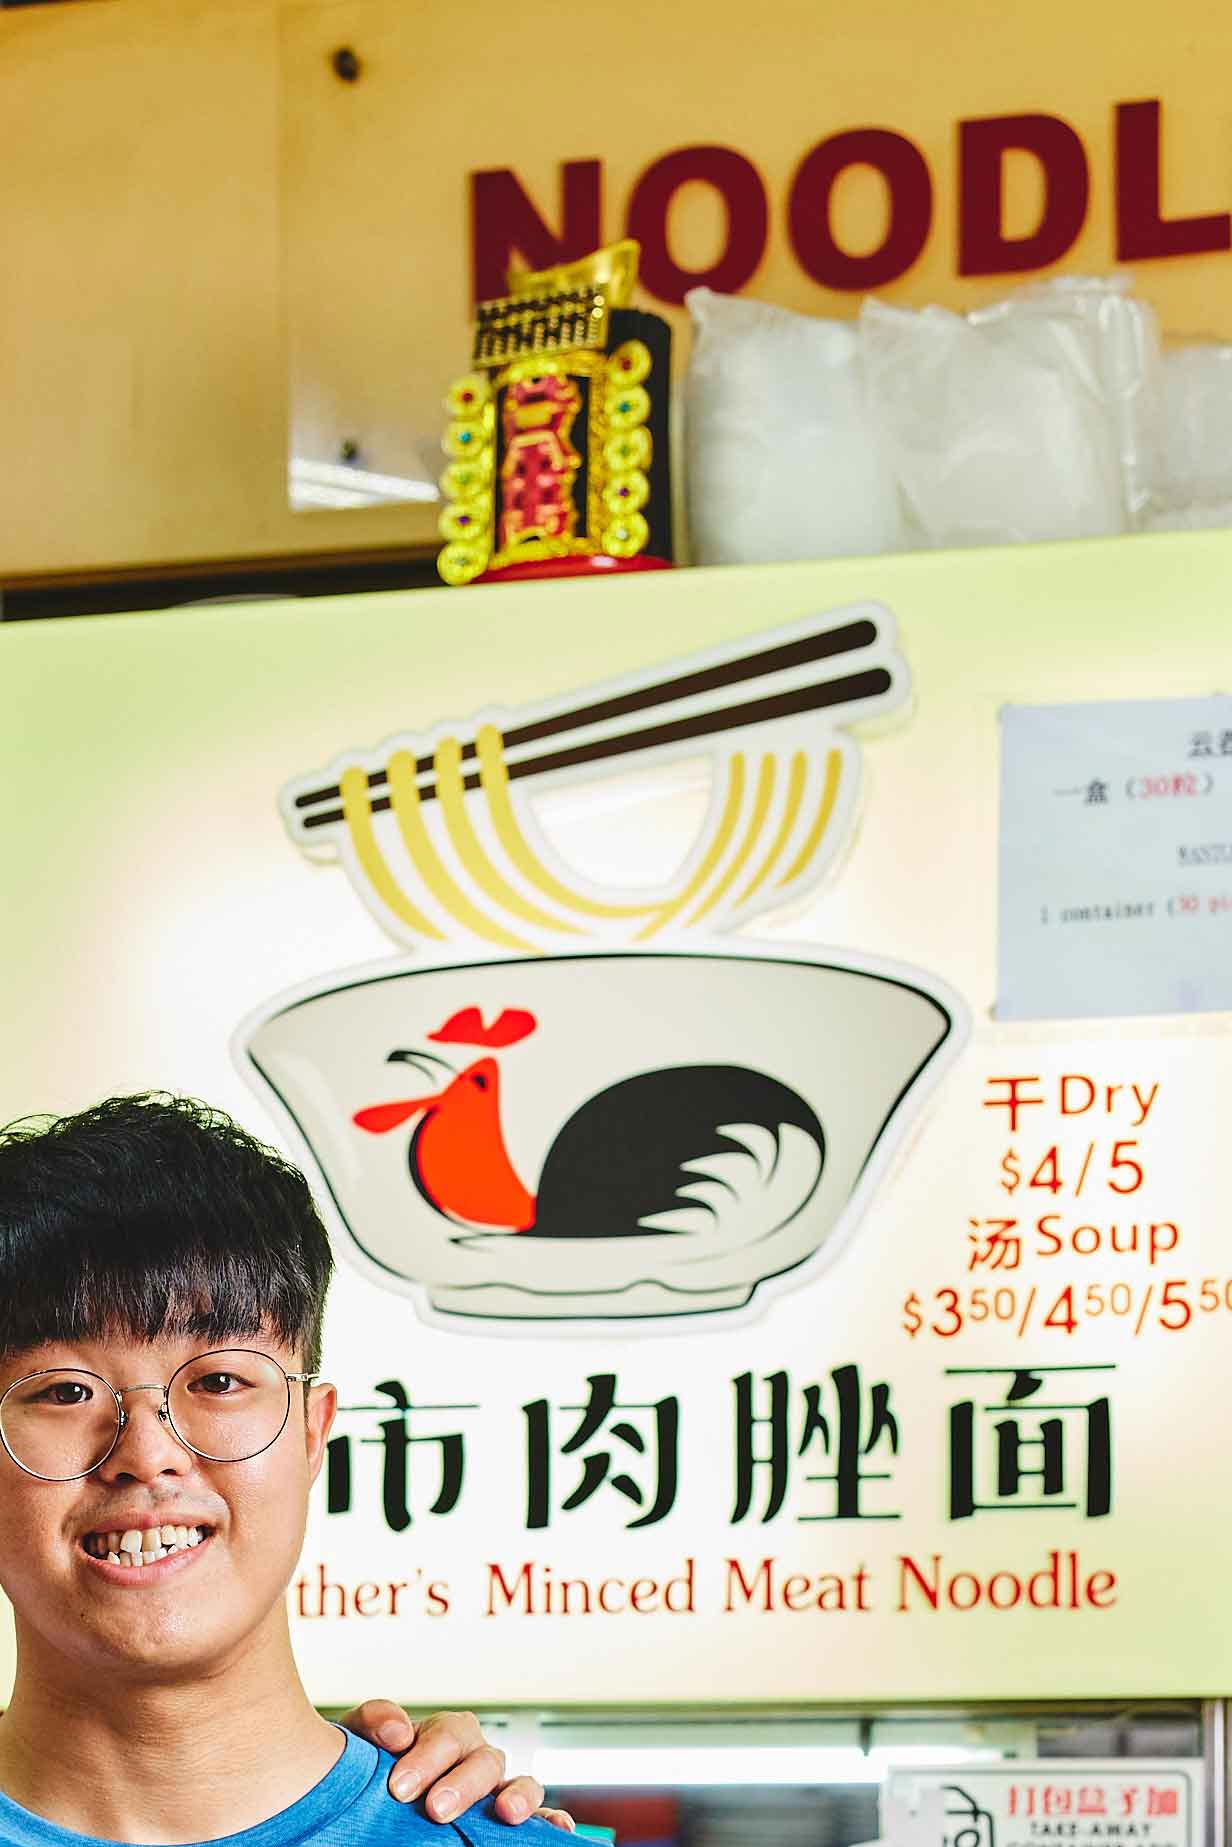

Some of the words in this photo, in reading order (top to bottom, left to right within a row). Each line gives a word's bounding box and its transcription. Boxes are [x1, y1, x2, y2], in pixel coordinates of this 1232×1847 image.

[983, 1076, 1044, 1131] 干
[1060, 1074, 1159, 1127] Dry
[1000, 1140, 1144, 1197] $4/5
[967, 1217, 1022, 1271] 汤
[1035, 1214, 1179, 1266] Soup
[295, 1564, 450, 1618] ther's
[486, 1558, 696, 1616] Minced
[723, 1557, 869, 1612] Meat
[898, 1549, 1119, 1611] Noodle
